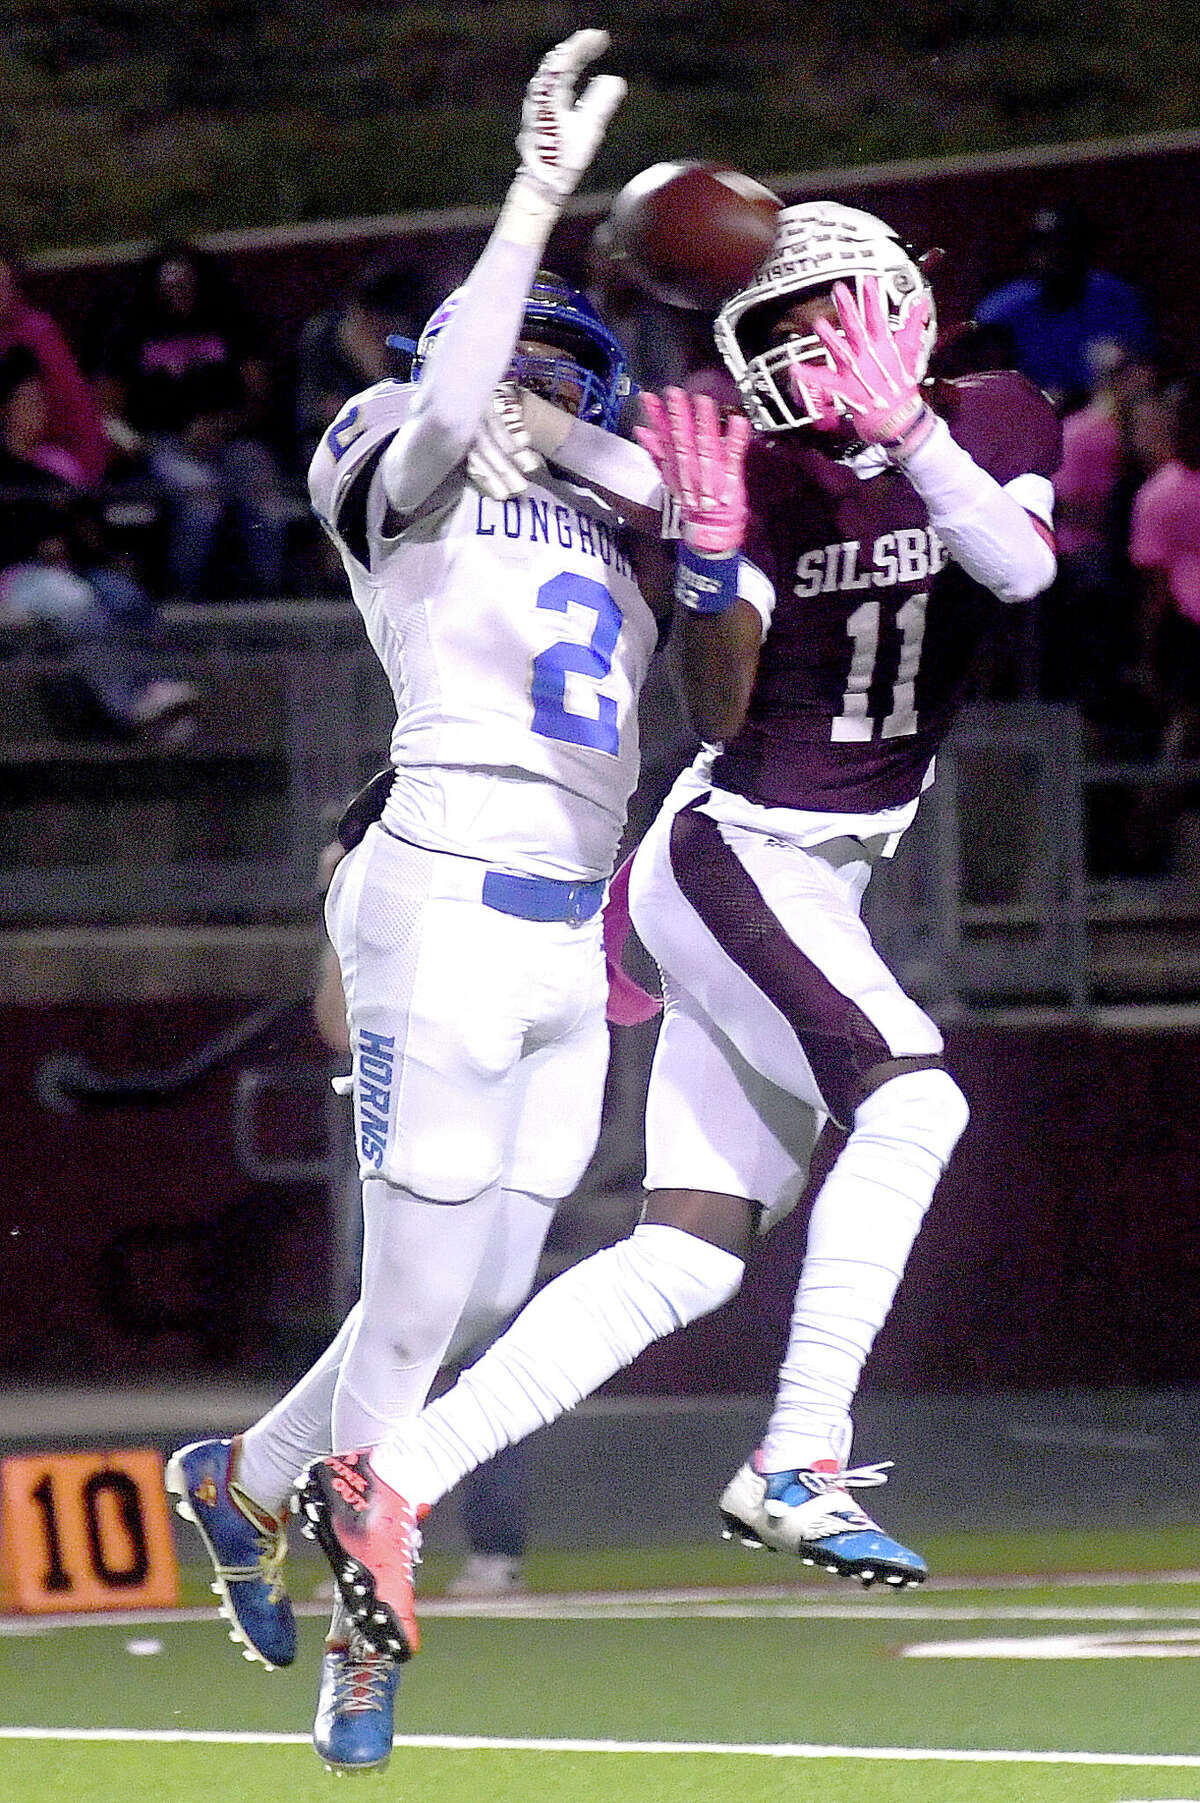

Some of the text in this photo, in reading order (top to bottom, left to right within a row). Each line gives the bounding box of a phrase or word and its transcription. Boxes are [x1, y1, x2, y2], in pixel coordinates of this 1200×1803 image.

[476, 495, 636, 584] LONGHO
[530, 570, 625, 757] 2
[830, 592, 930, 743] 11
[359, 1028, 395, 1170] HORNS
[32, 1466, 150, 1593] 10
